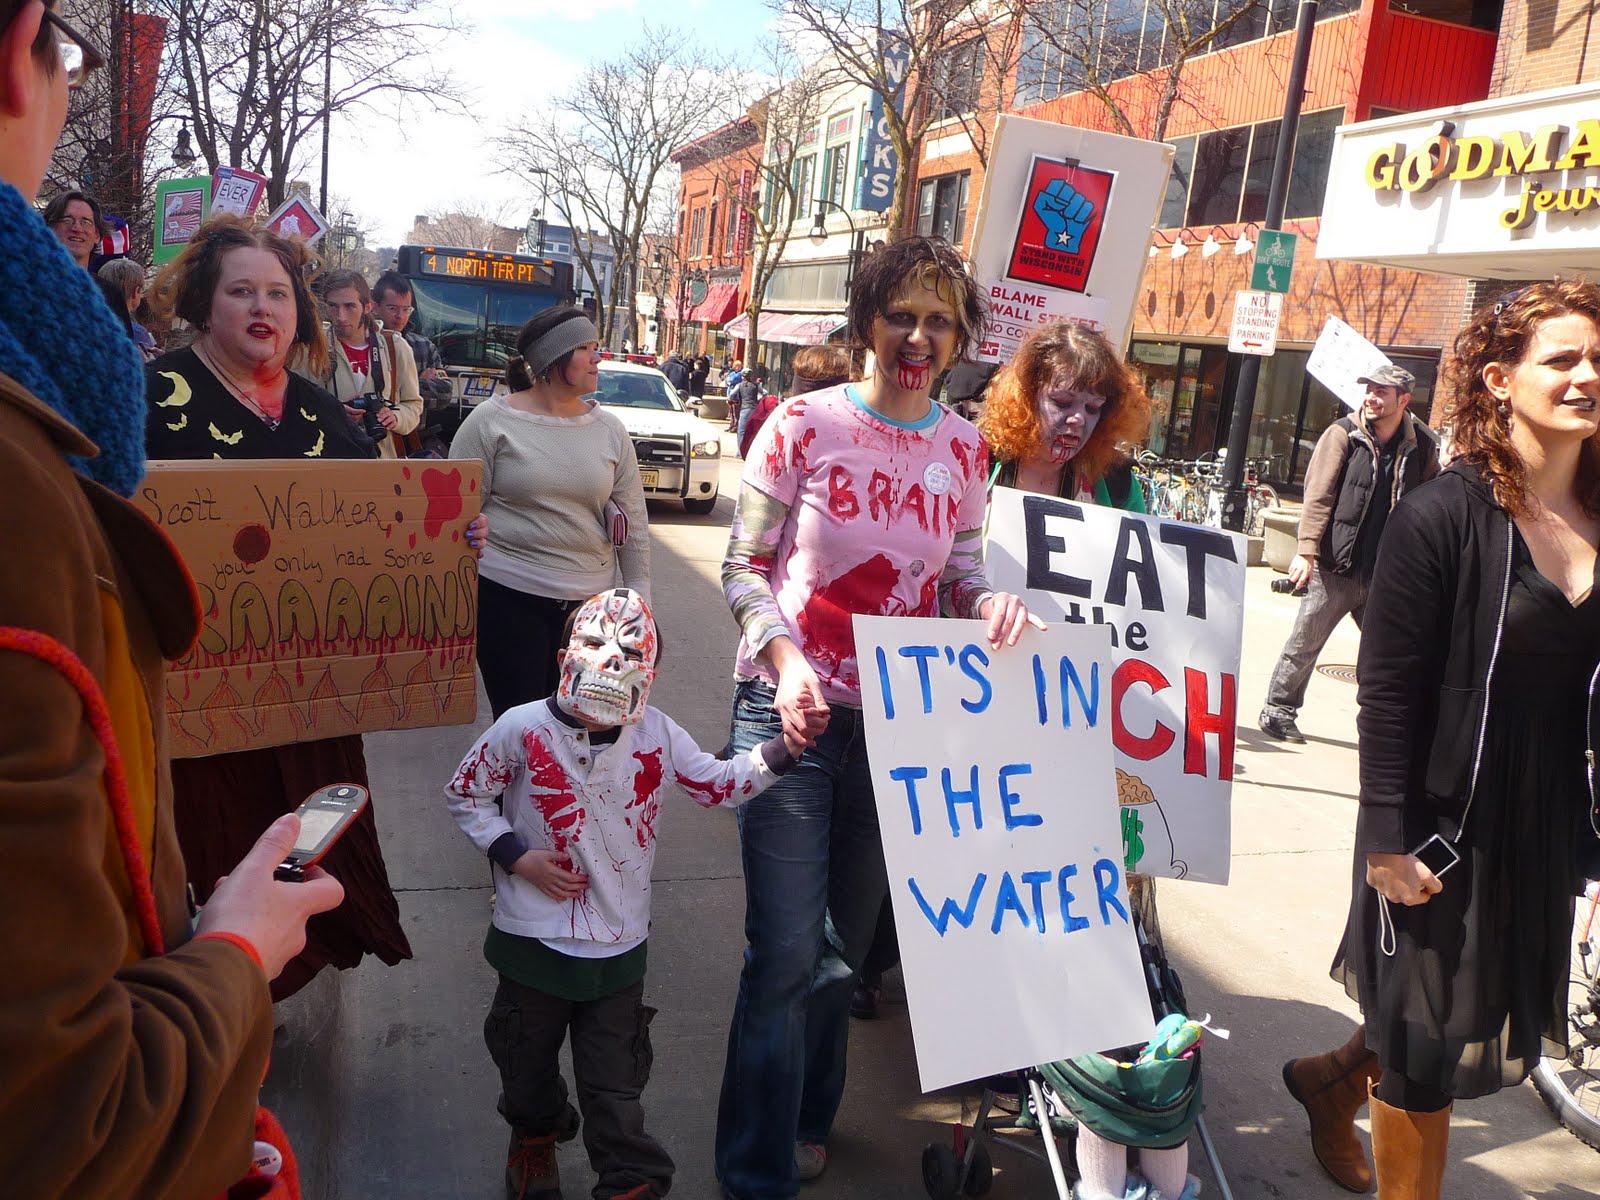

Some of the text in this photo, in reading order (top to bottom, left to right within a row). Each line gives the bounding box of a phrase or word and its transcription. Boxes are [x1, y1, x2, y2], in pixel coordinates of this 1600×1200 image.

[220, 183, 249, 202] EVER
[1019, 255, 1083, 276] WISCONSIN
[1021, 246, 1085, 267] STAND WITH
[1257, 256, 1291, 267] BIKE ROUTE
[428, 254, 534, 283] 4 NORTH TFR PT
[991, 286, 1047, 308] BLAME
[1251, 296, 1267, 307] NO
[989, 302, 1033, 322] WALL
[1236, 317, 1275, 329] STANDING
[1238, 307, 1277, 319] STOPPING
[1237, 330, 1270, 341] PARKING
[143, 487, 221, 525] Scott
[213, 562, 255, 590] you
[274, 547, 323, 582] only
[333, 544, 371, 567] had
[1023, 495, 1238, 620] EAT
[1064, 602, 1150, 652] the
[875, 643, 1099, 730] IT'S IN
[1111, 658, 1236, 782] CH
[889, 764, 1044, 837] THE
[908, 857, 1129, 938] WATER
